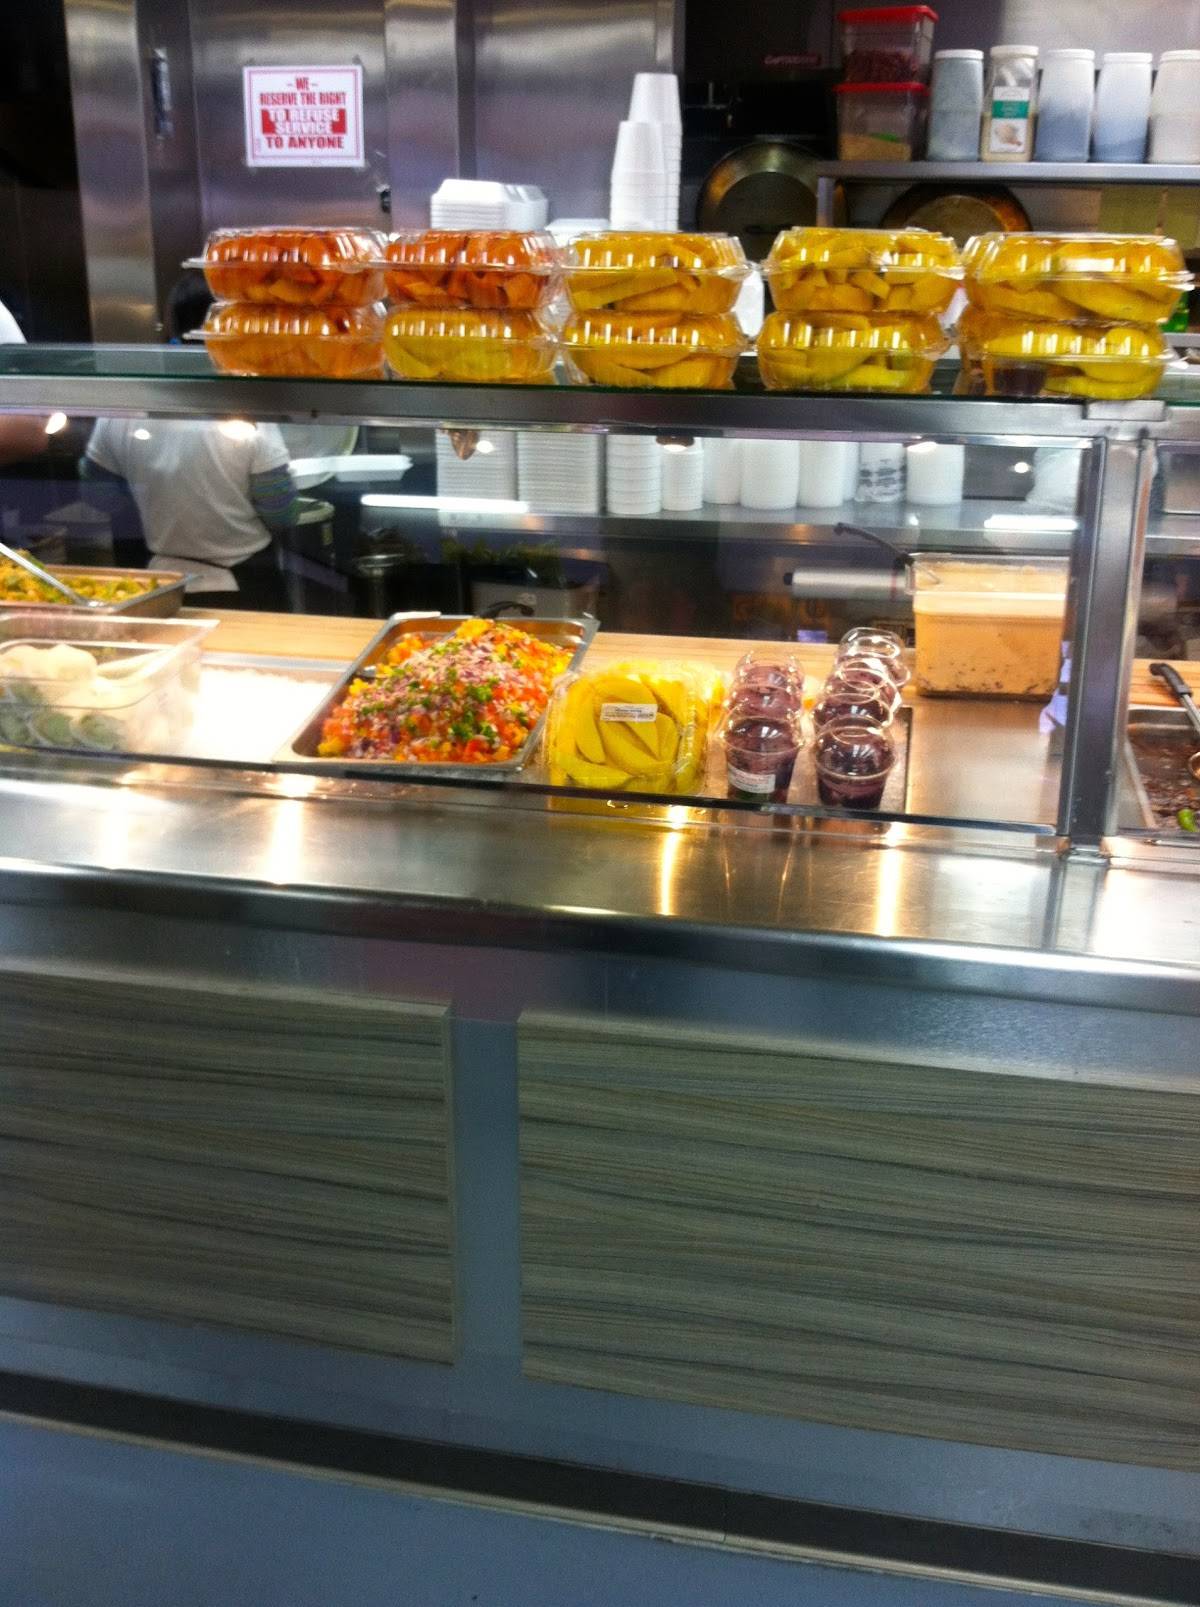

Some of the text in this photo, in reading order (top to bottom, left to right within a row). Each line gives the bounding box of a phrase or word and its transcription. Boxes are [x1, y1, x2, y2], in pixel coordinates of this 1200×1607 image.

[300, 92, 317, 106] THE
[270, 109, 340, 122] TO REFUSE
[275, 122, 331, 134] SERVICE
[265, 136, 284, 149] TO
[288, 136, 345, 149] ANYONE
